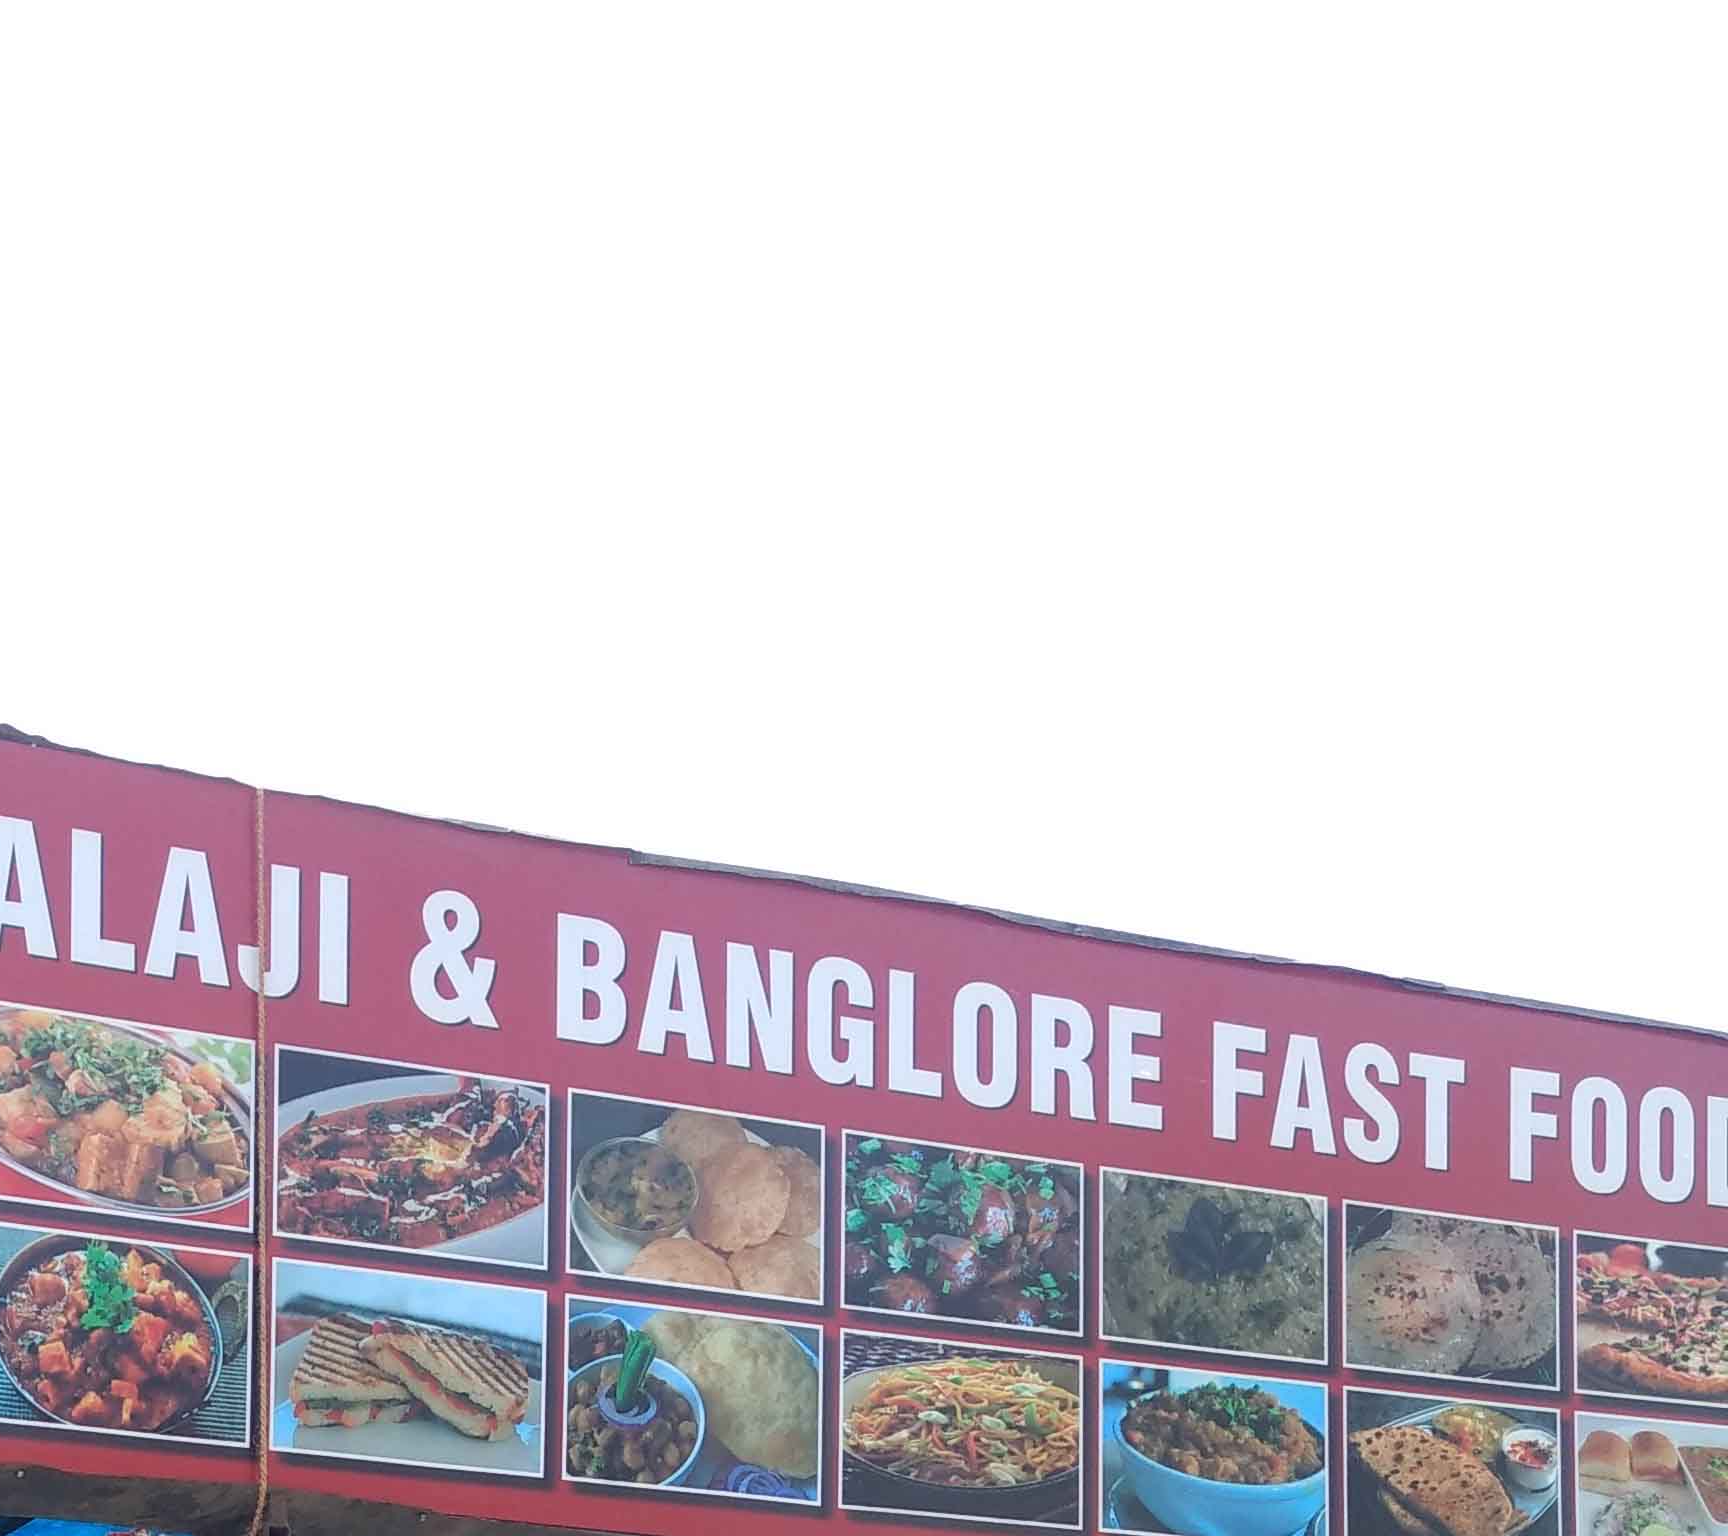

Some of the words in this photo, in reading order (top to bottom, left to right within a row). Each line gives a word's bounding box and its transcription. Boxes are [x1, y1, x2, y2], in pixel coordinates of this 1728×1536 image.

[410, 889, 499, 1030] &
[556, 910, 1164, 1131] BANGLORE
[1211, 1020, 1466, 1171] FAST
